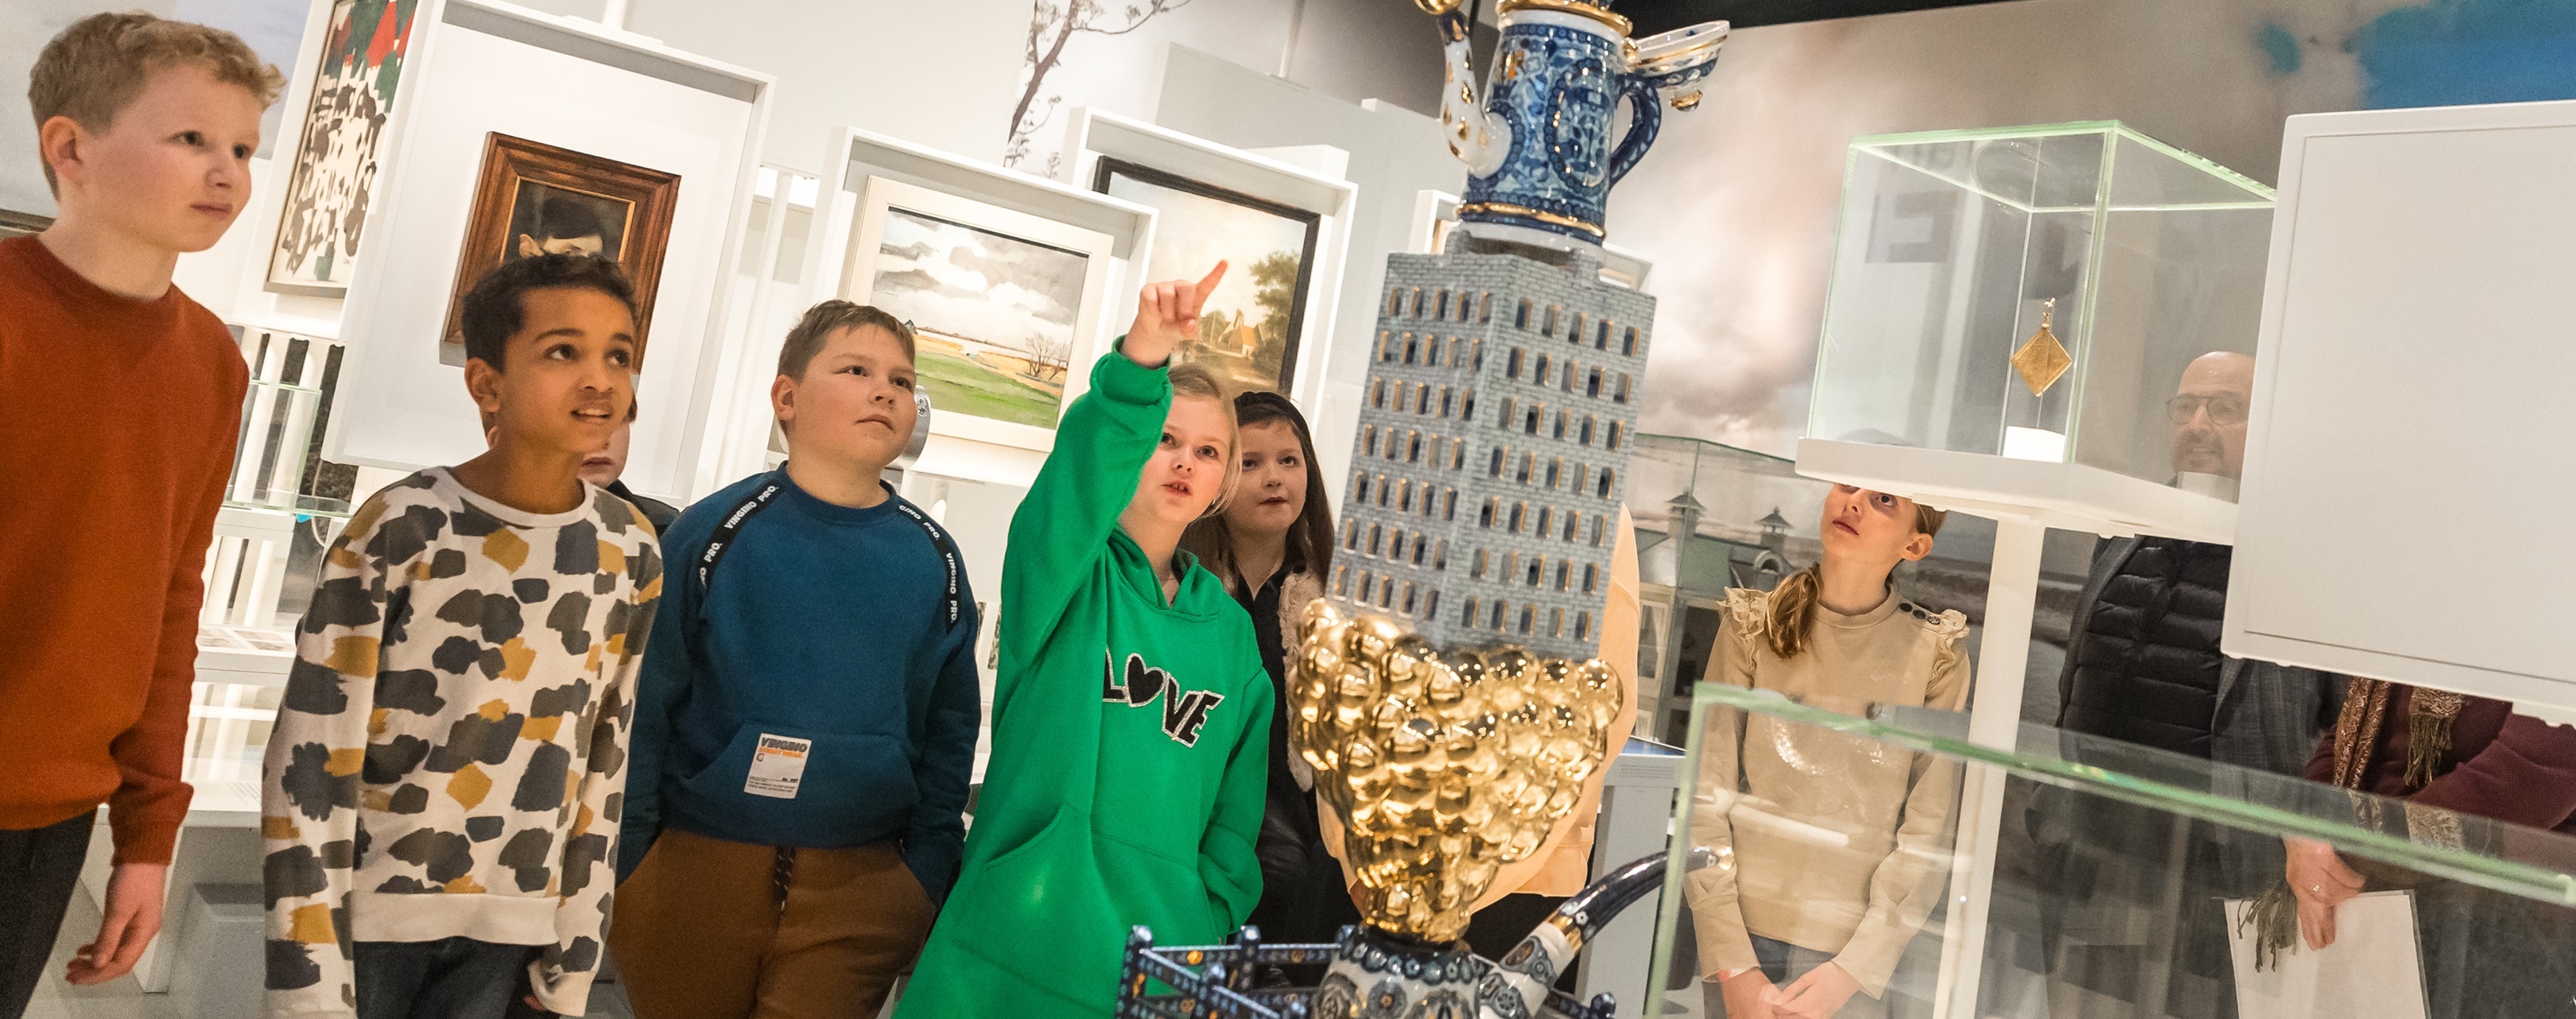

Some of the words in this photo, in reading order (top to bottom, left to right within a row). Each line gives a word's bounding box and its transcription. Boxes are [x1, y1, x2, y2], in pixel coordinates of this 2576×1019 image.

[724, 501, 757, 529] VINGINO
[946, 552, 956, 595] VINGINO
[1102, 645, 1225, 749] LOVE
[761, 737, 808, 753] VINGINO
